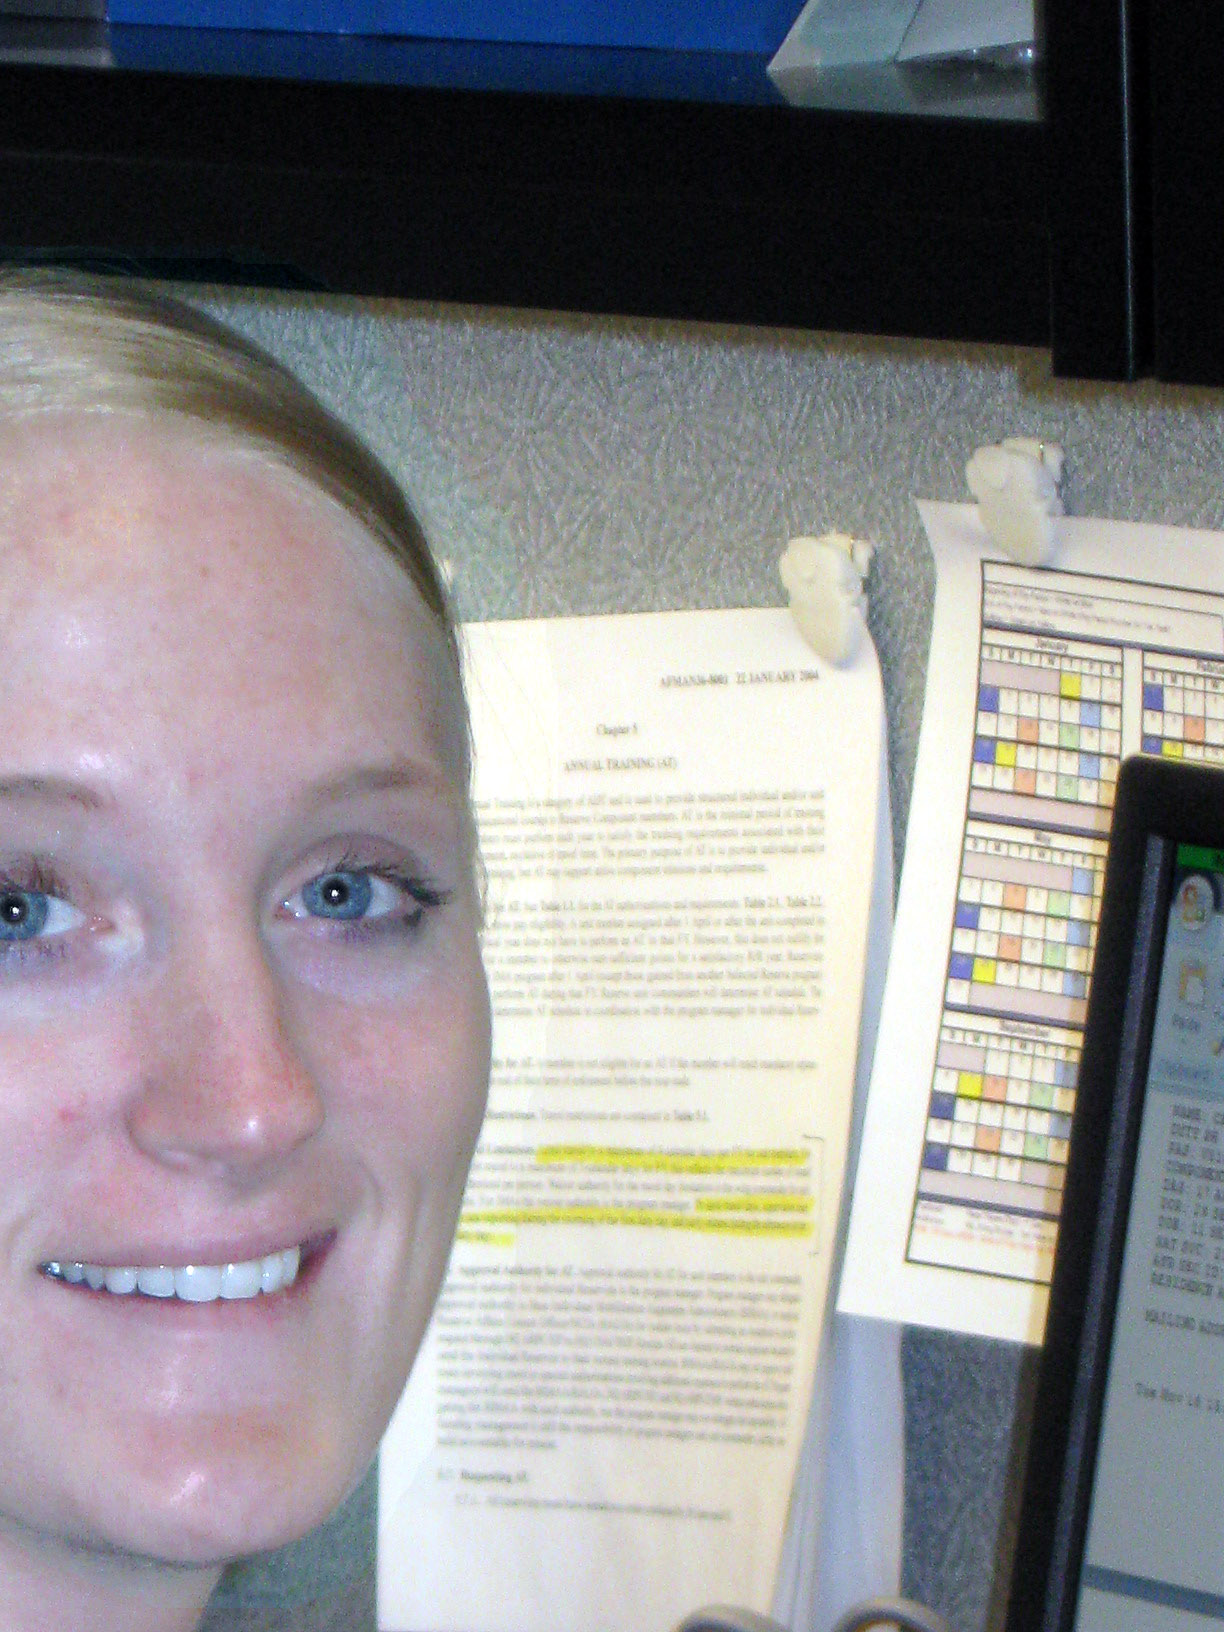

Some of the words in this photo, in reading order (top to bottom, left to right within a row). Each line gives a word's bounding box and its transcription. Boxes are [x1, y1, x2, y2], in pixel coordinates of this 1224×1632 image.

[749, 670, 795, 684] JANUARY
[596, 724, 630, 737] Chapter
[564, 759, 603, 771] ANNUAL
[606, 757, 654, 770] TRAINING
